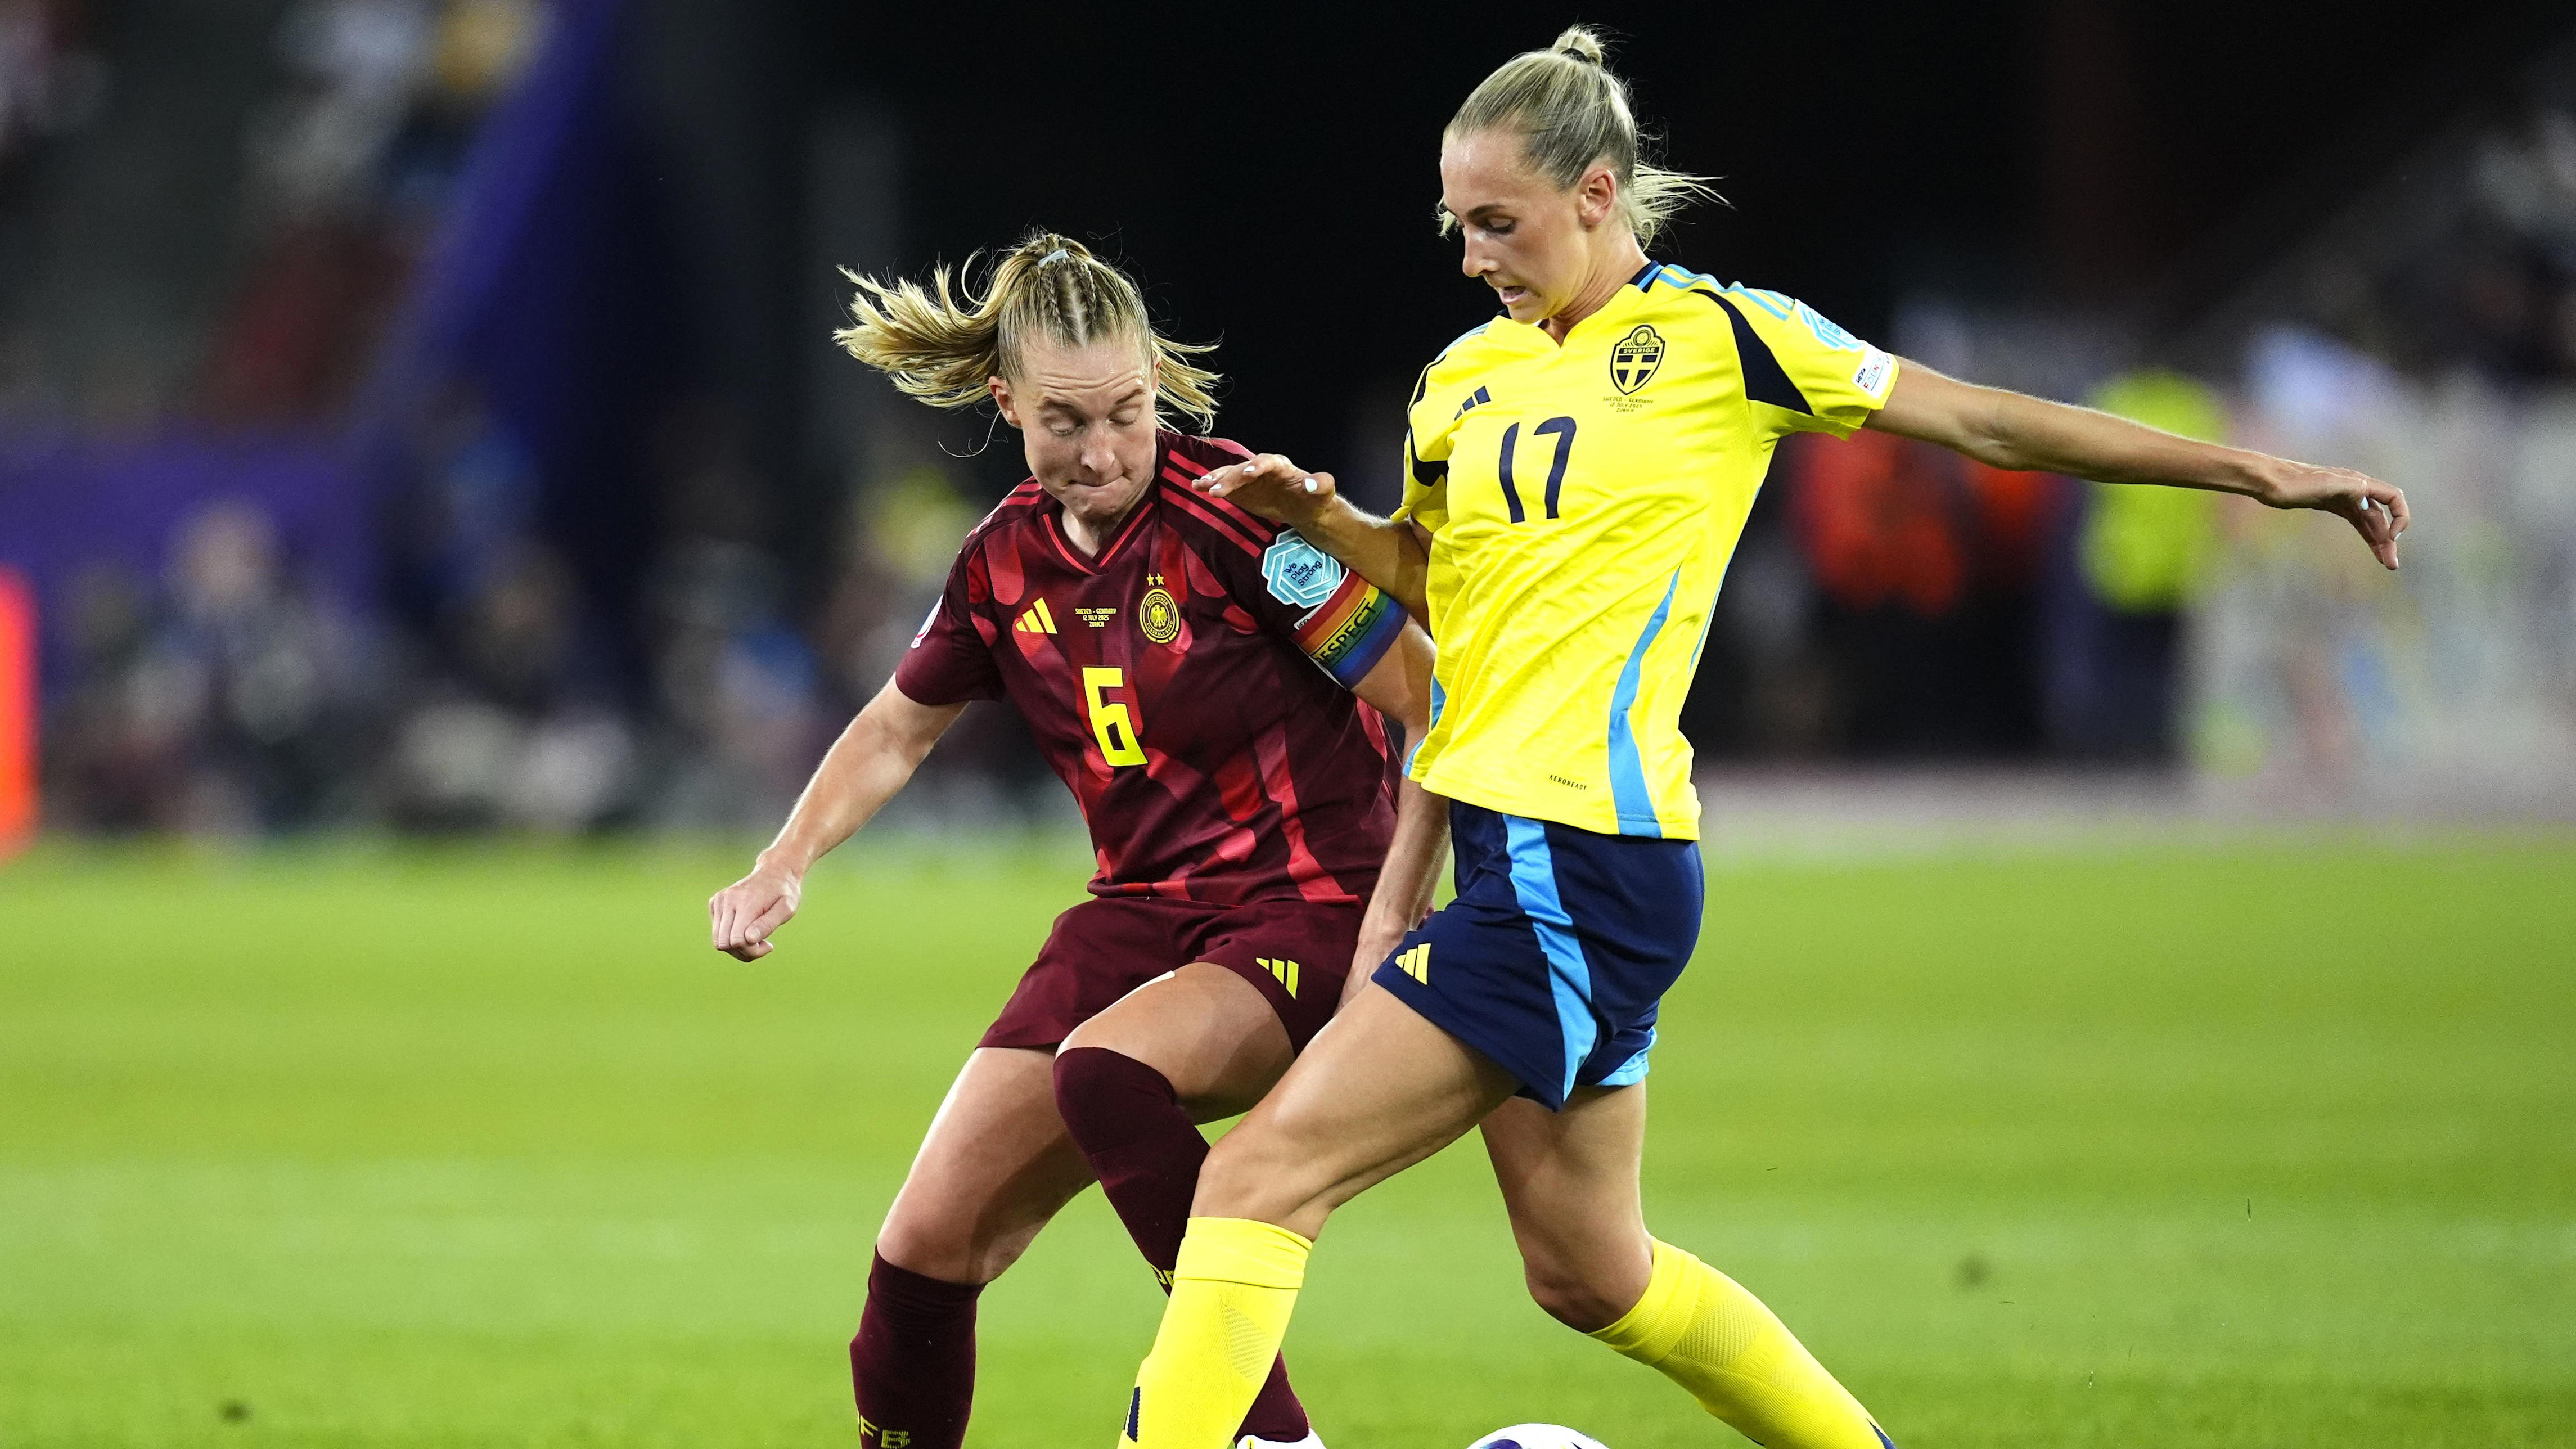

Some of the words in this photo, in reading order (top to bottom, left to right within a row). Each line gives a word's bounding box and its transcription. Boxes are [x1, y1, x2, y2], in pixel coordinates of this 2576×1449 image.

[1856, 368, 1866, 384] UEFA
[1499, 416, 1577, 524] 17
[1284, 562, 1297, 573] We
[1291, 563, 1309, 581] Play
[1298, 560, 1323, 586] Strong
[1147, 596, 1168, 607] DEUTSCHER
[1082, 667, 1149, 766] 6
[1549, 775, 1587, 790] AEROREADY
[857, 1406, 911, 1449] FB
